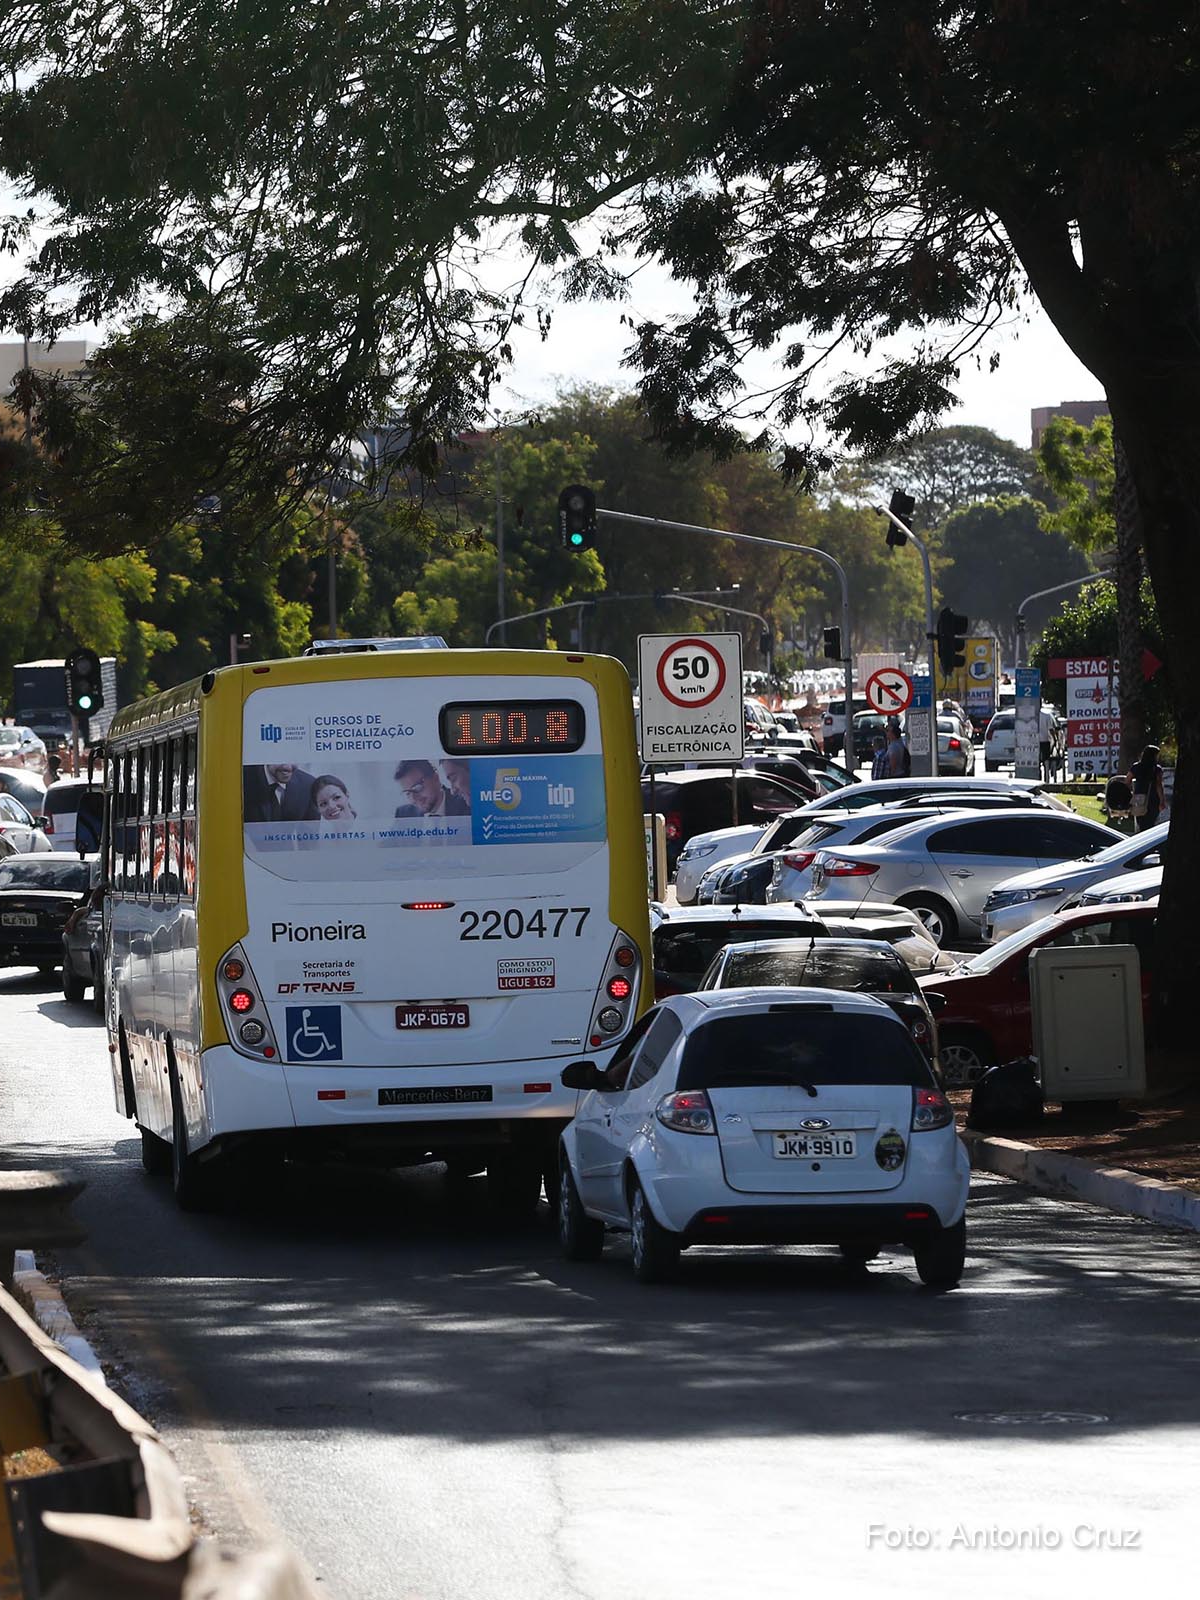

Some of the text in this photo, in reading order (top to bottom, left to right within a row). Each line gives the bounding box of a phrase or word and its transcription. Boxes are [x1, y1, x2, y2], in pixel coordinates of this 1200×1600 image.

[672, 656, 710, 680] 50
[680, 685, 706, 694] km/h
[1024, 686, 1032, 697] 2
[915, 695, 921, 706] 1
[1069, 708, 1120, 718] PROMOÇ
[314, 714, 382, 726] CURSOS DE
[260, 723, 282, 743] idp
[315, 724, 415, 739] ESPECIALIZAÇÃO
[457, 711, 568, 744] 100.8
[646, 722, 737, 736] FISCALIZAÇÃO
[315, 740, 382, 751] EM DIREITO
[1073, 734, 1094, 745] R$
[652, 740, 732, 753] ELETRÔNICA
[1073, 750, 1104, 758] DEMAIS
[1074, 760, 1094, 772] R$
[480, 790, 512, 801] MEC
[547, 783, 575, 808] idp
[264, 827, 459, 841] INSCRIÇÕES ABERTAS www.idp.edu.br
[271, 907, 591, 943] Pioneira 220477
[302, 960, 355, 969] Secretaria de
[499, 966, 547, 974] DIRIGINDO?
[303, 970, 351, 978] Transportes
[499, 976, 552, 988] LIGUE 162
[384, 1087, 489, 1104] Mercedes-Benz
